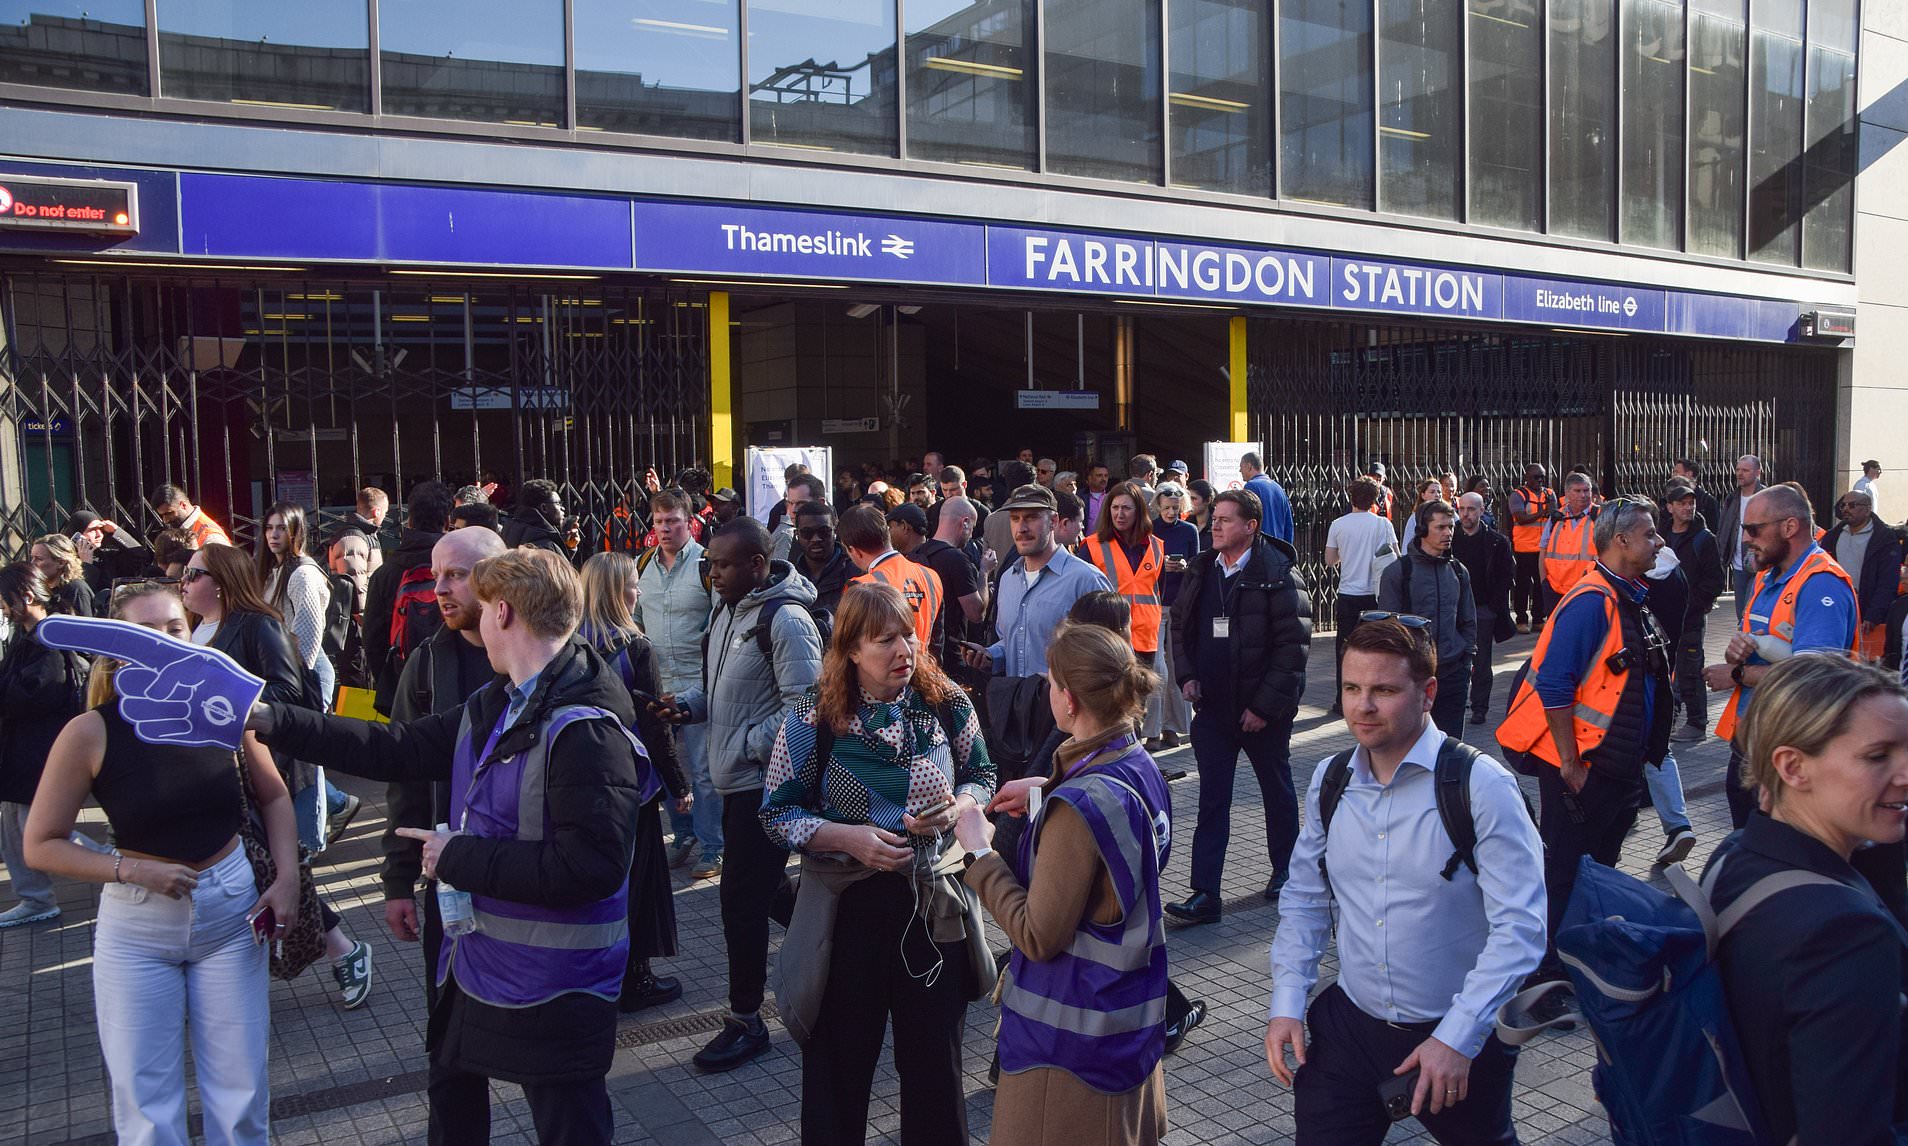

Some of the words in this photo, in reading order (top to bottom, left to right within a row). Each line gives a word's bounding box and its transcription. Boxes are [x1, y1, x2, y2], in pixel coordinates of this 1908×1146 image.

[14, 202, 36, 217] Do
[40, 204, 65, 218] not
[66, 206, 105, 220] enter
[721, 224, 873, 257] Thameslink
[1025, 236, 1314, 298] FARRINGDON
[1343, 263, 1483, 311] STATION
[1536, 289, 1595, 312] Elizabeth
[1598, 295, 1620, 314] line
